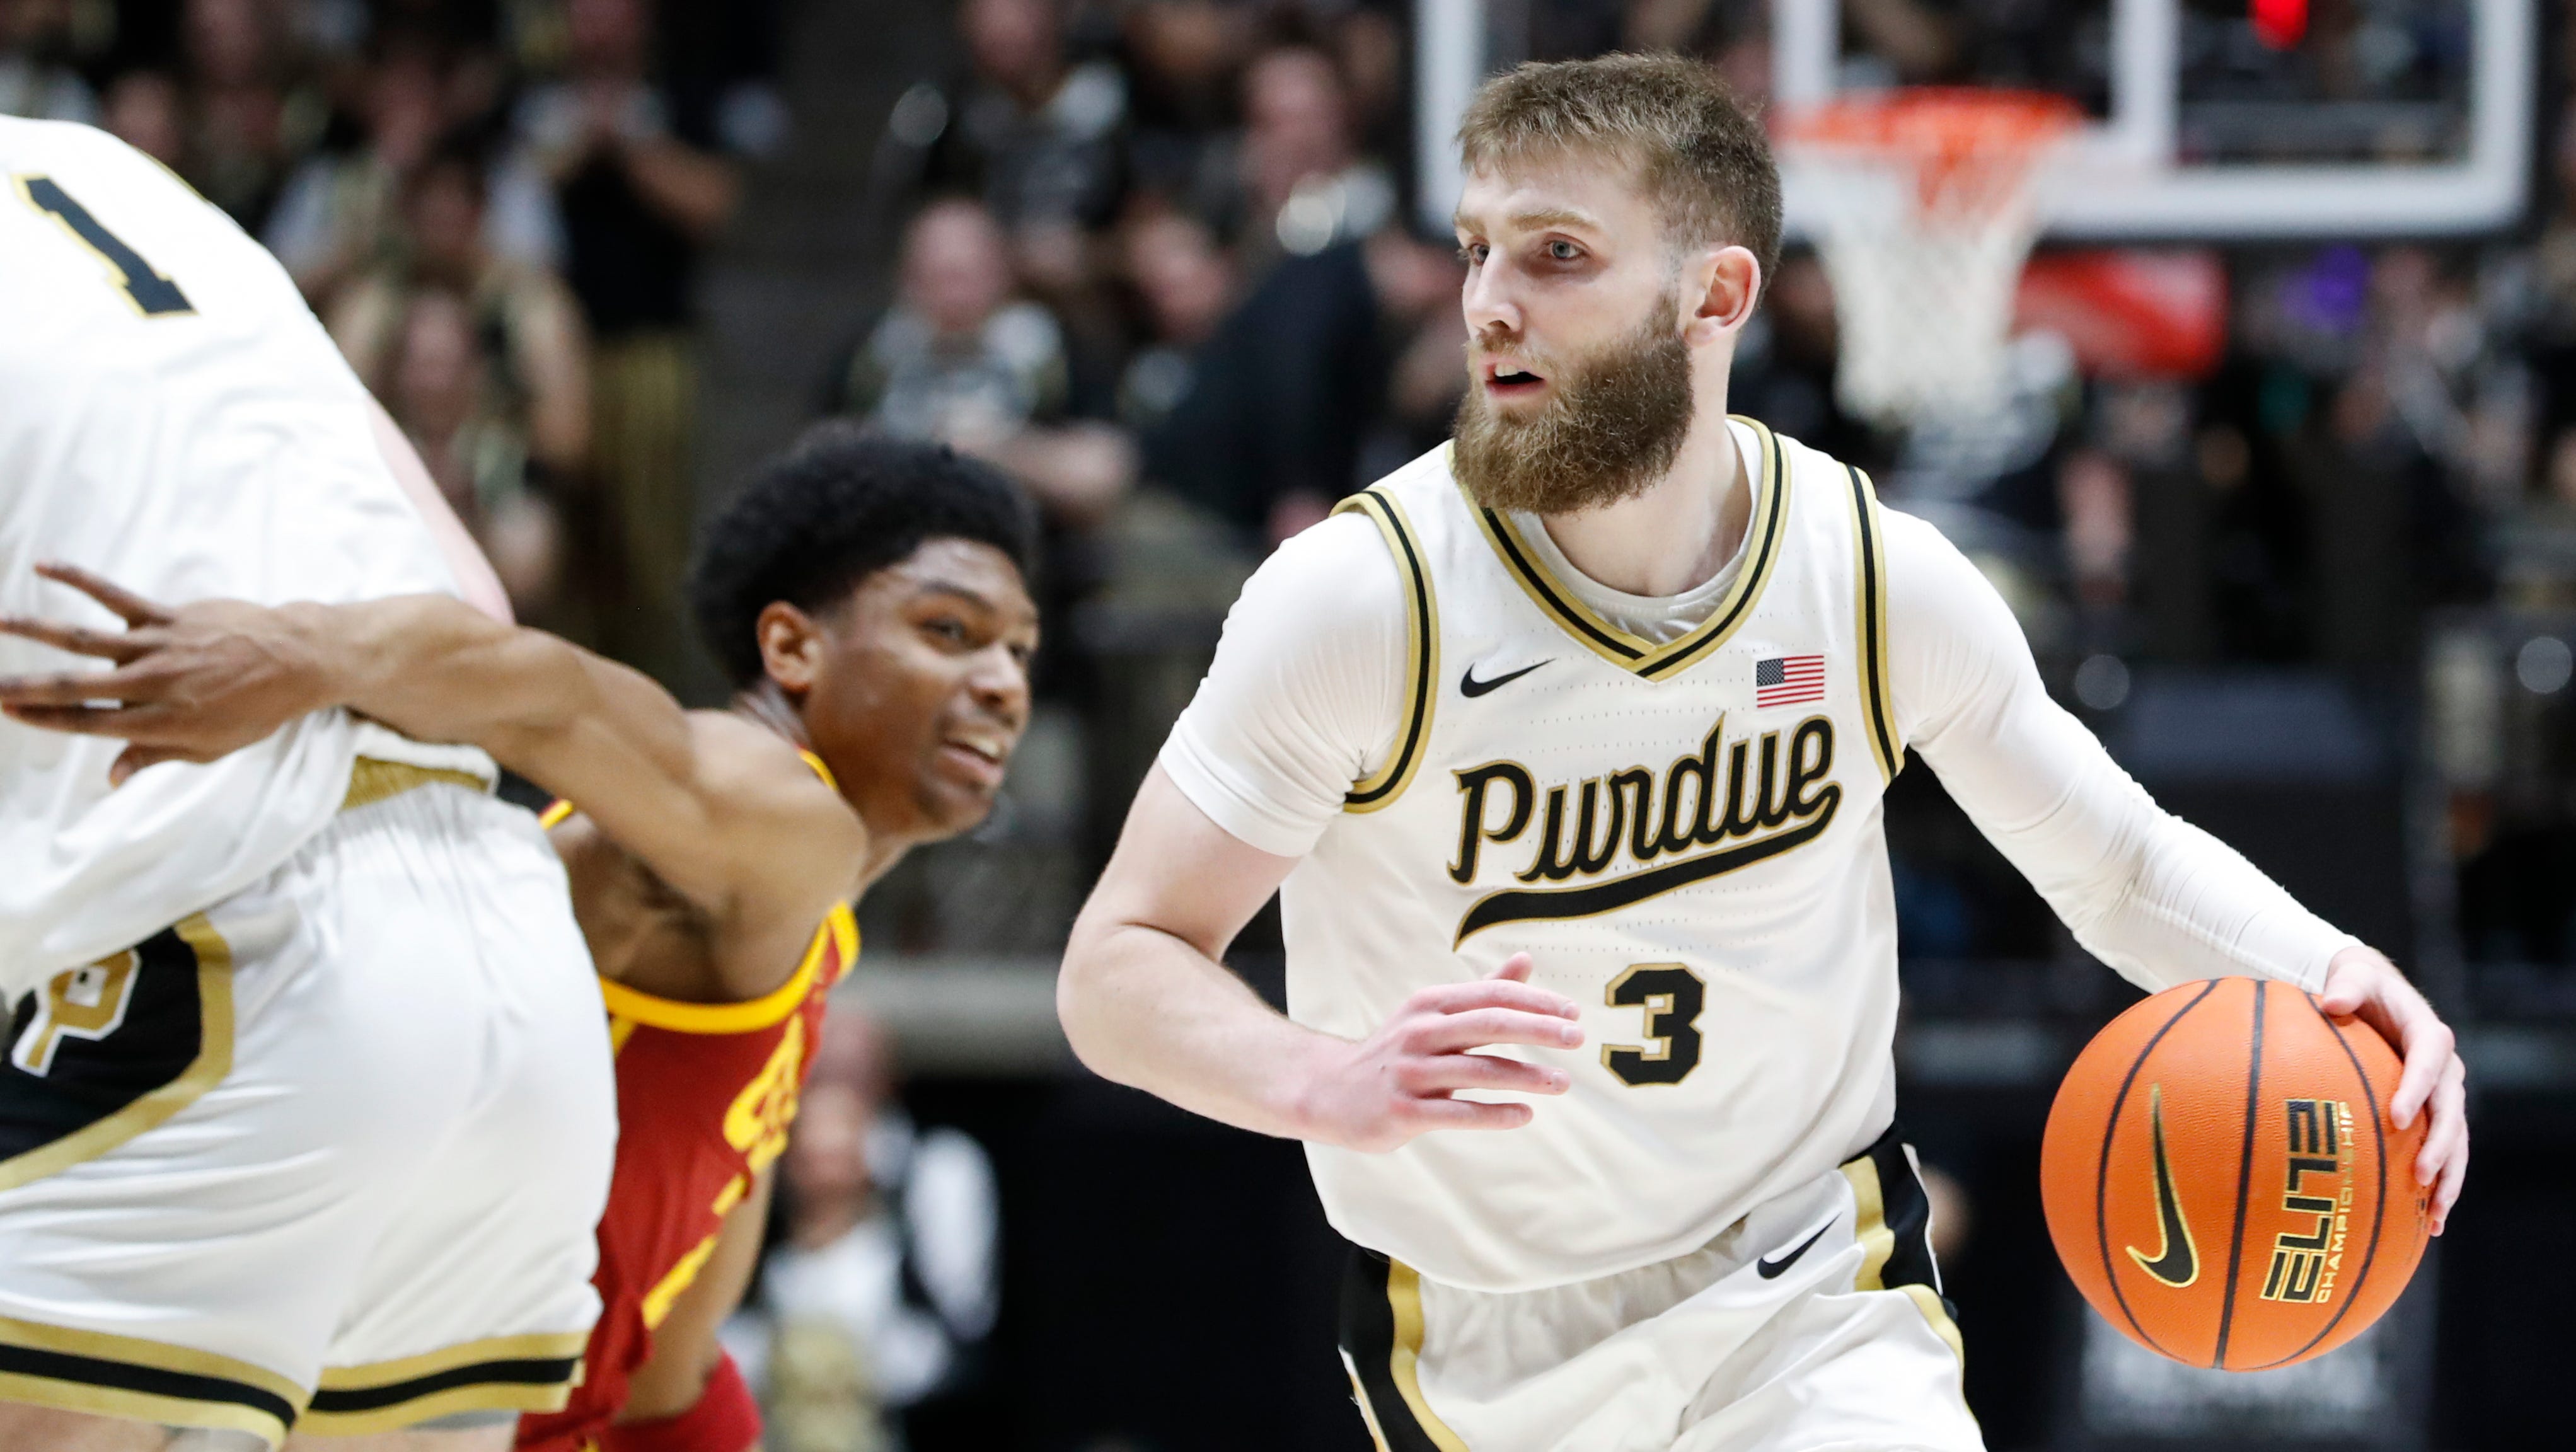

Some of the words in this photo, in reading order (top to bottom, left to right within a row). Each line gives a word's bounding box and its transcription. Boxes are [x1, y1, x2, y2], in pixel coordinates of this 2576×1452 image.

[11, 173, 199, 319] 1
[1448, 712, 1842, 885] Purdue
[1601, 964, 1705, 1085] 3
[2261, 1098, 2338, 1303] ELITE
[2316, 1102, 2354, 1303] CHAMPIONSHIP
